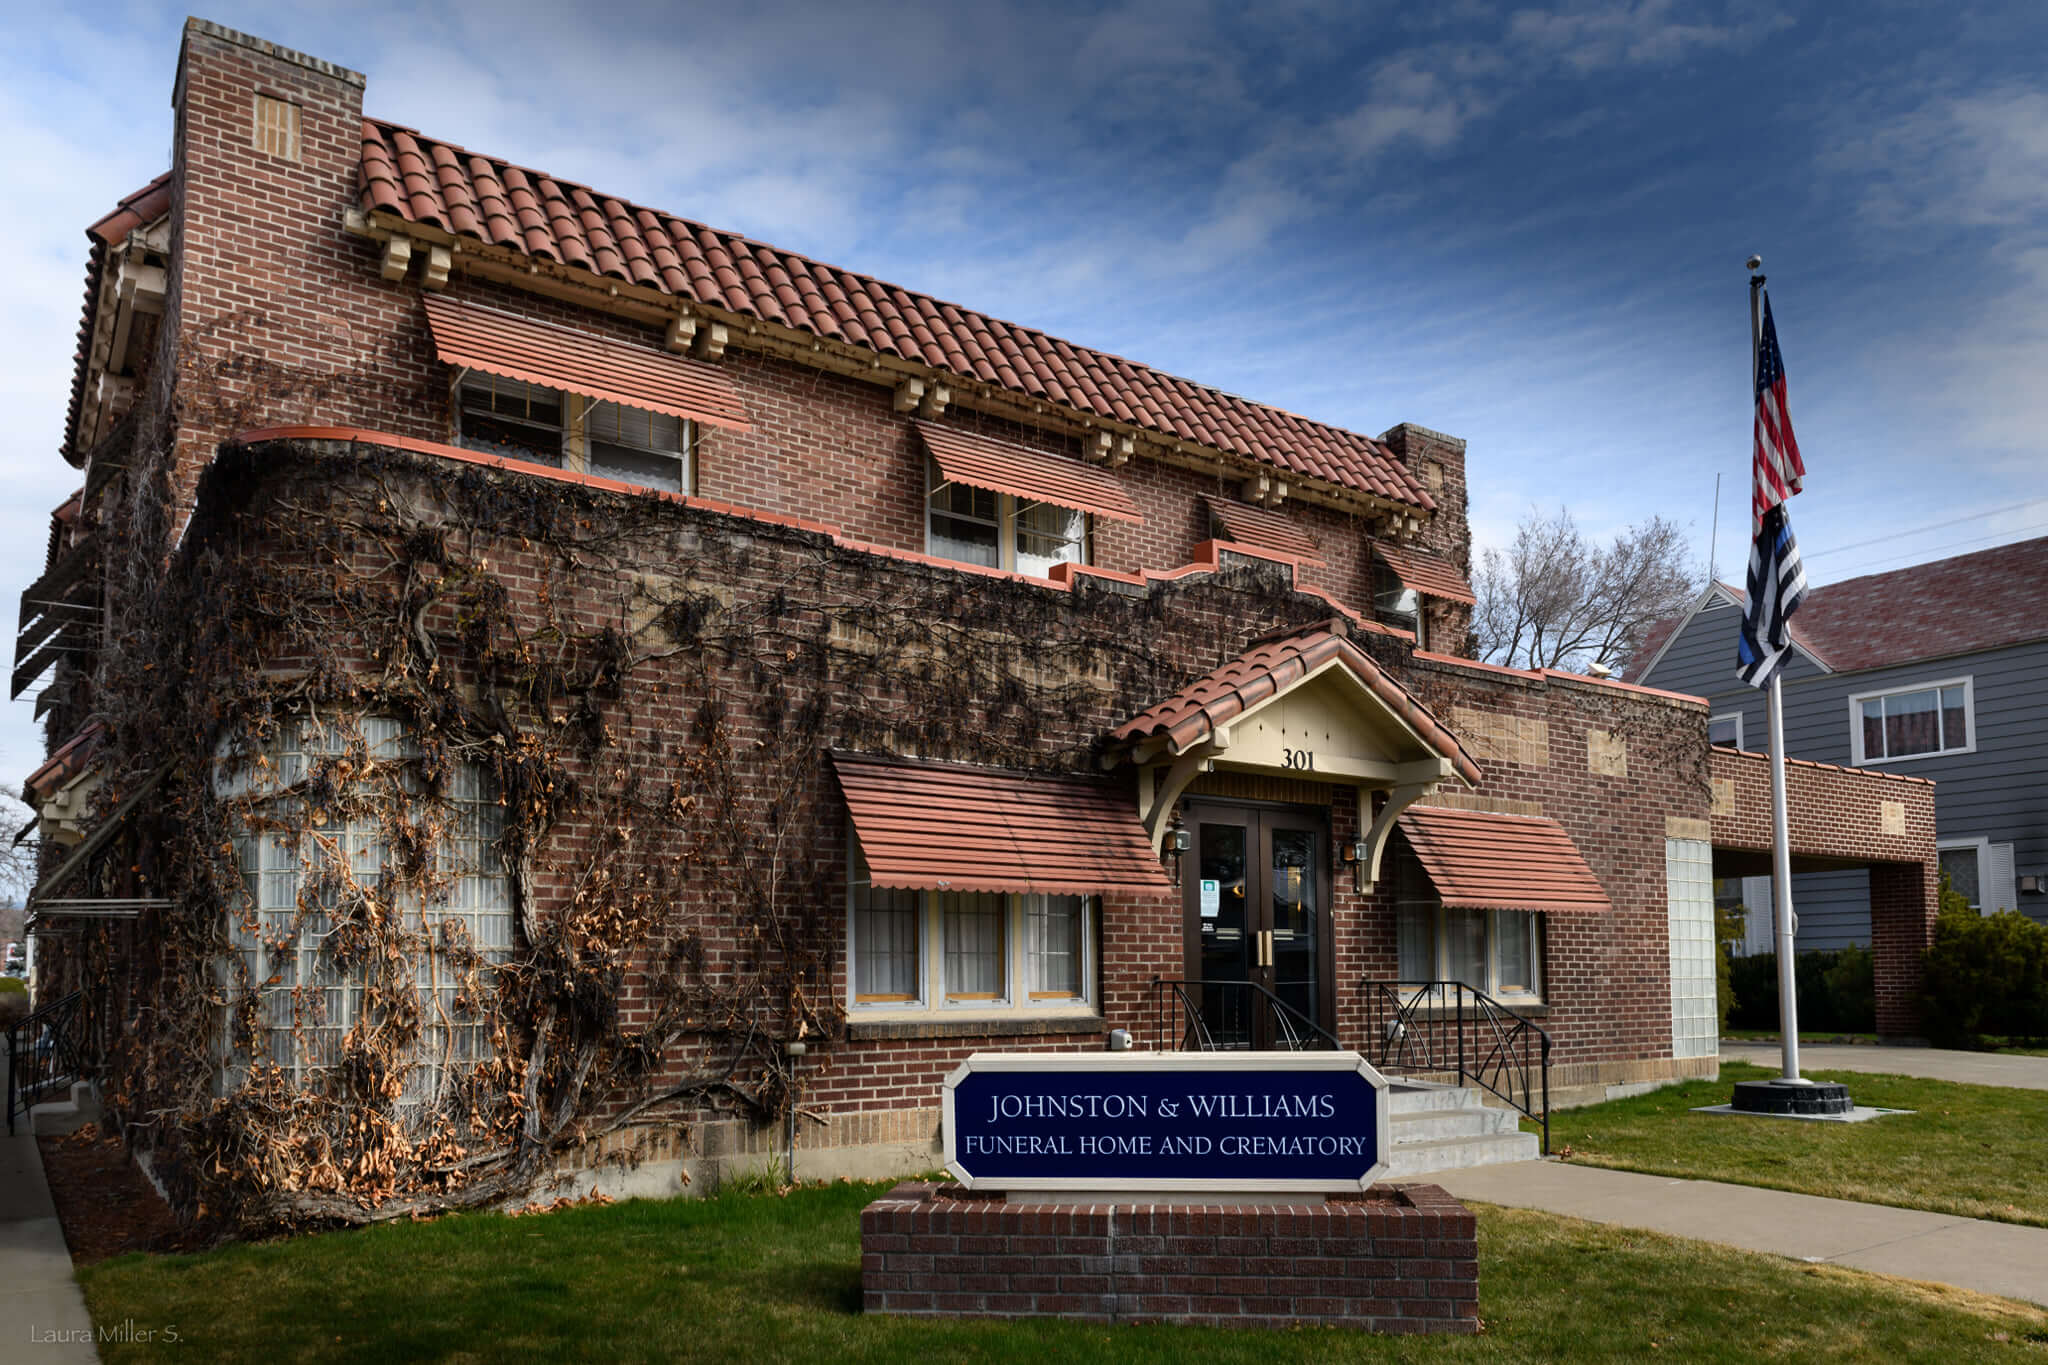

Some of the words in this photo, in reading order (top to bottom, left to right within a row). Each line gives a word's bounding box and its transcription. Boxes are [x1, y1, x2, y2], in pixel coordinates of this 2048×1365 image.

[1281, 748, 1315, 770] 301
[987, 1094, 1148, 1123] JOHNSTON
[1157, 1098, 1179, 1118] &
[1187, 1094, 1336, 1118] WILLIAMS
[965, 1136, 1073, 1155] FUNERAL
[1079, 1136, 1152, 1155] HOME
[1159, 1136, 1213, 1155] AND
[1219, 1136, 1367, 1156] CREMATORY
